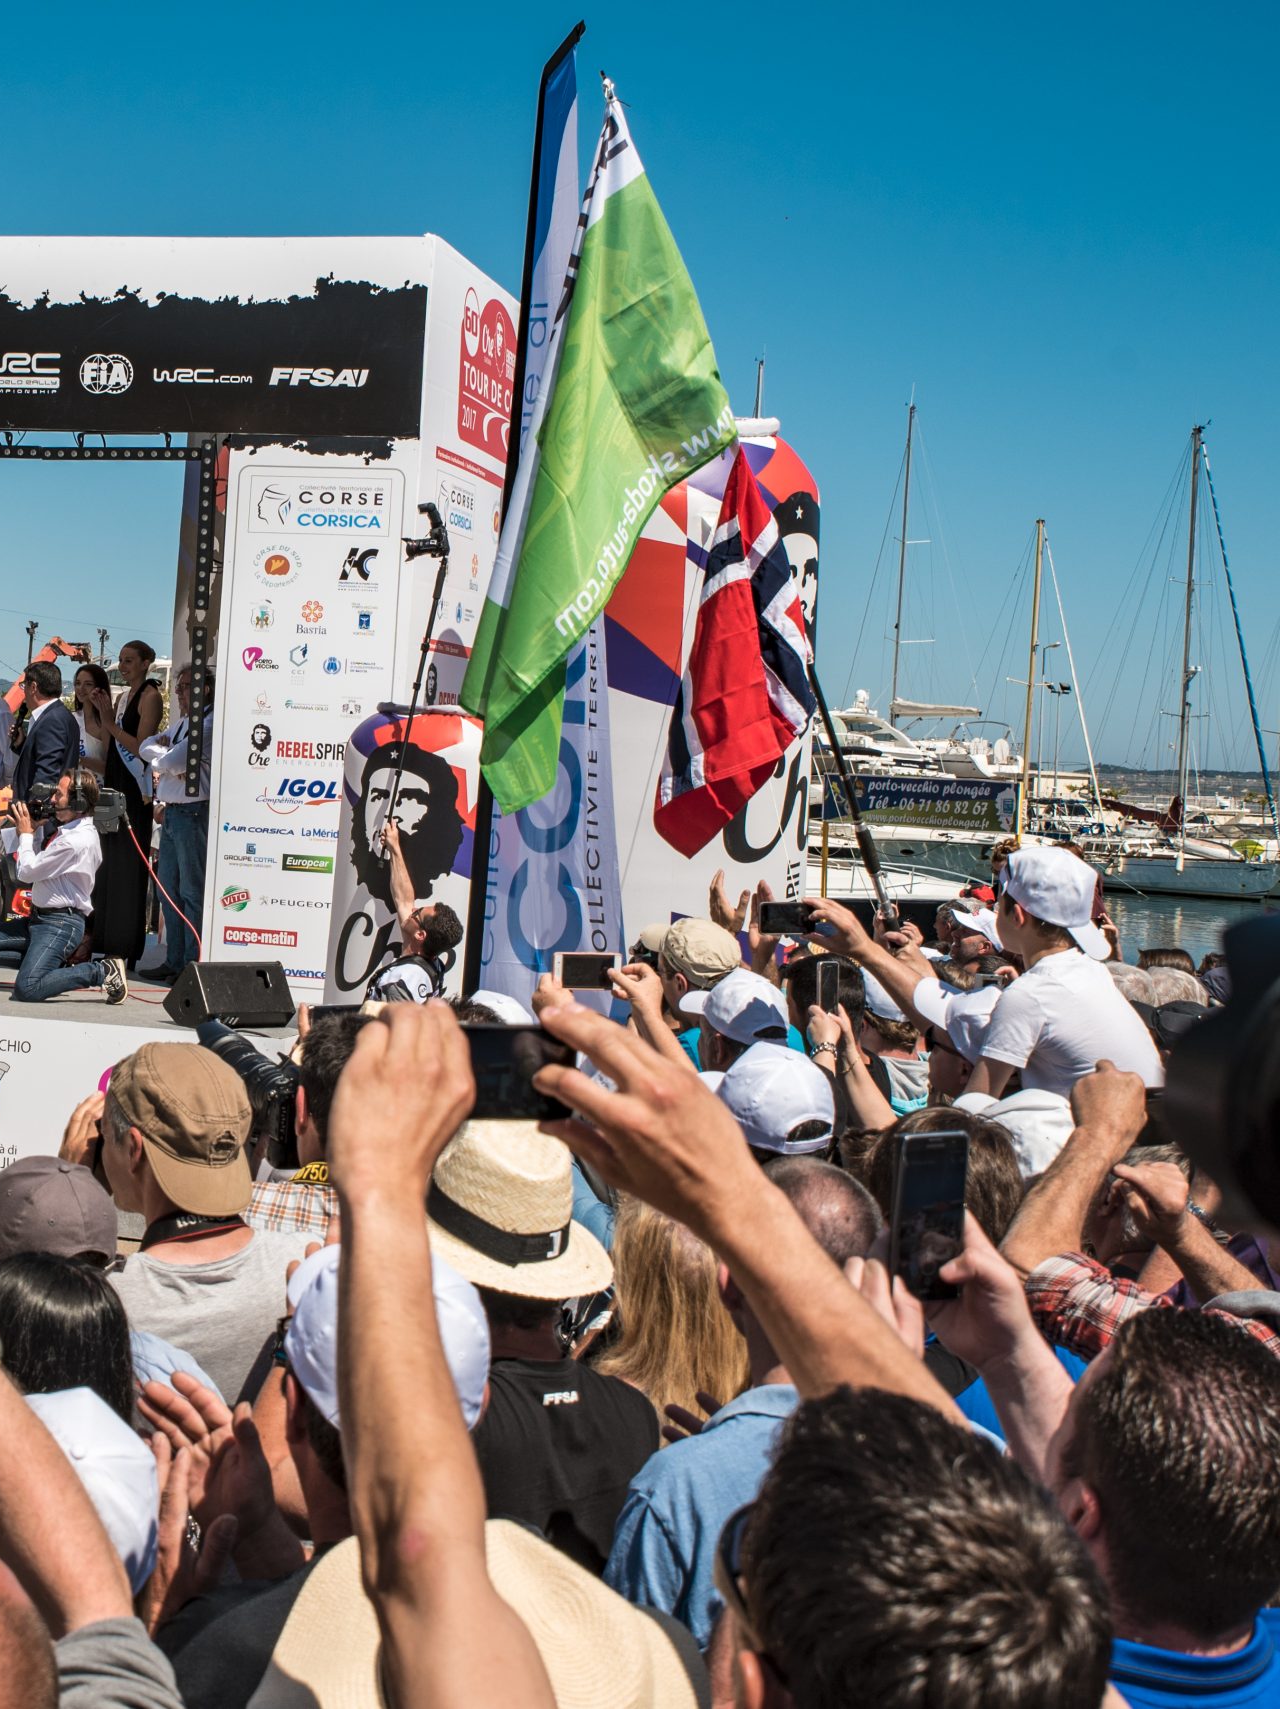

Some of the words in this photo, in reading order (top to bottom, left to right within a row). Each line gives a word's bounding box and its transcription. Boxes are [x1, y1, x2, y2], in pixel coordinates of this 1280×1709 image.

[464, 361, 488, 399] TOUR
[491, 379, 502, 408] DE
[462, 405, 477, 431] 2017
[299, 491, 383, 506] CORSE
[451, 491, 474, 511] CORSE
[297, 513, 381, 528] CORSICA
[253, 545, 276, 567] CORSE
[279, 544, 290, 552] DU
[291, 550, 302, 568] SUD
[587, 627, 599, 730] TERRIT
[277, 741, 344, 760] REBELSPIR
[248, 752, 270, 767] Che
[867, 780, 939, 795] porto-vecchio
[942, 782, 991, 798] plongée
[256, 794, 304, 805] Compétition
[899, 798, 915, 811] 06
[919, 799, 931, 812] 71
[935, 800, 950, 813] 86
[953, 801, 969, 814] 82
[972, 801, 988, 816] 67
[248, 826, 294, 835] CORSICA
[301, 827, 311, 836] La
[224, 854, 252, 862] GROUPE
[254, 856, 277, 864] COTAL
[286, 856, 329, 868] Europcar
[271, 898, 332, 909] PEUGEOT
[225, 929, 295, 946] corse-matin
[283, 968, 326, 979] ovence
[7, 1144, 18, 1155] di
